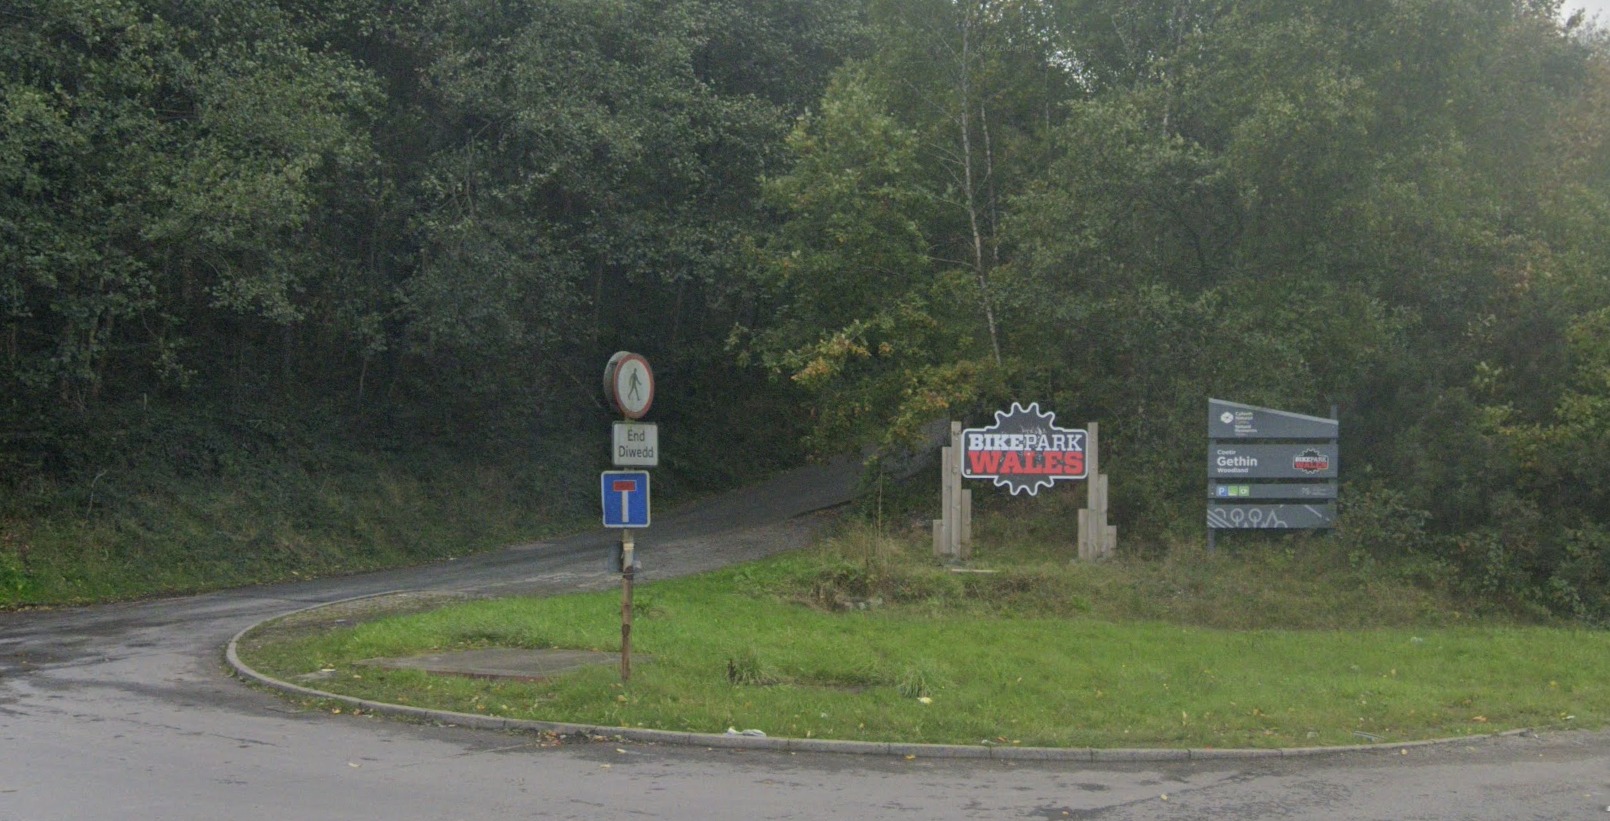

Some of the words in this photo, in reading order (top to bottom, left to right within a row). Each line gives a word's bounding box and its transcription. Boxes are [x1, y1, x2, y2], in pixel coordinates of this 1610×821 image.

[627, 430, 645, 442] End
[618, 445, 654, 458] Diwedd
[968, 451, 1084, 474] WALES
[1217, 456, 1258, 467] Gethin
